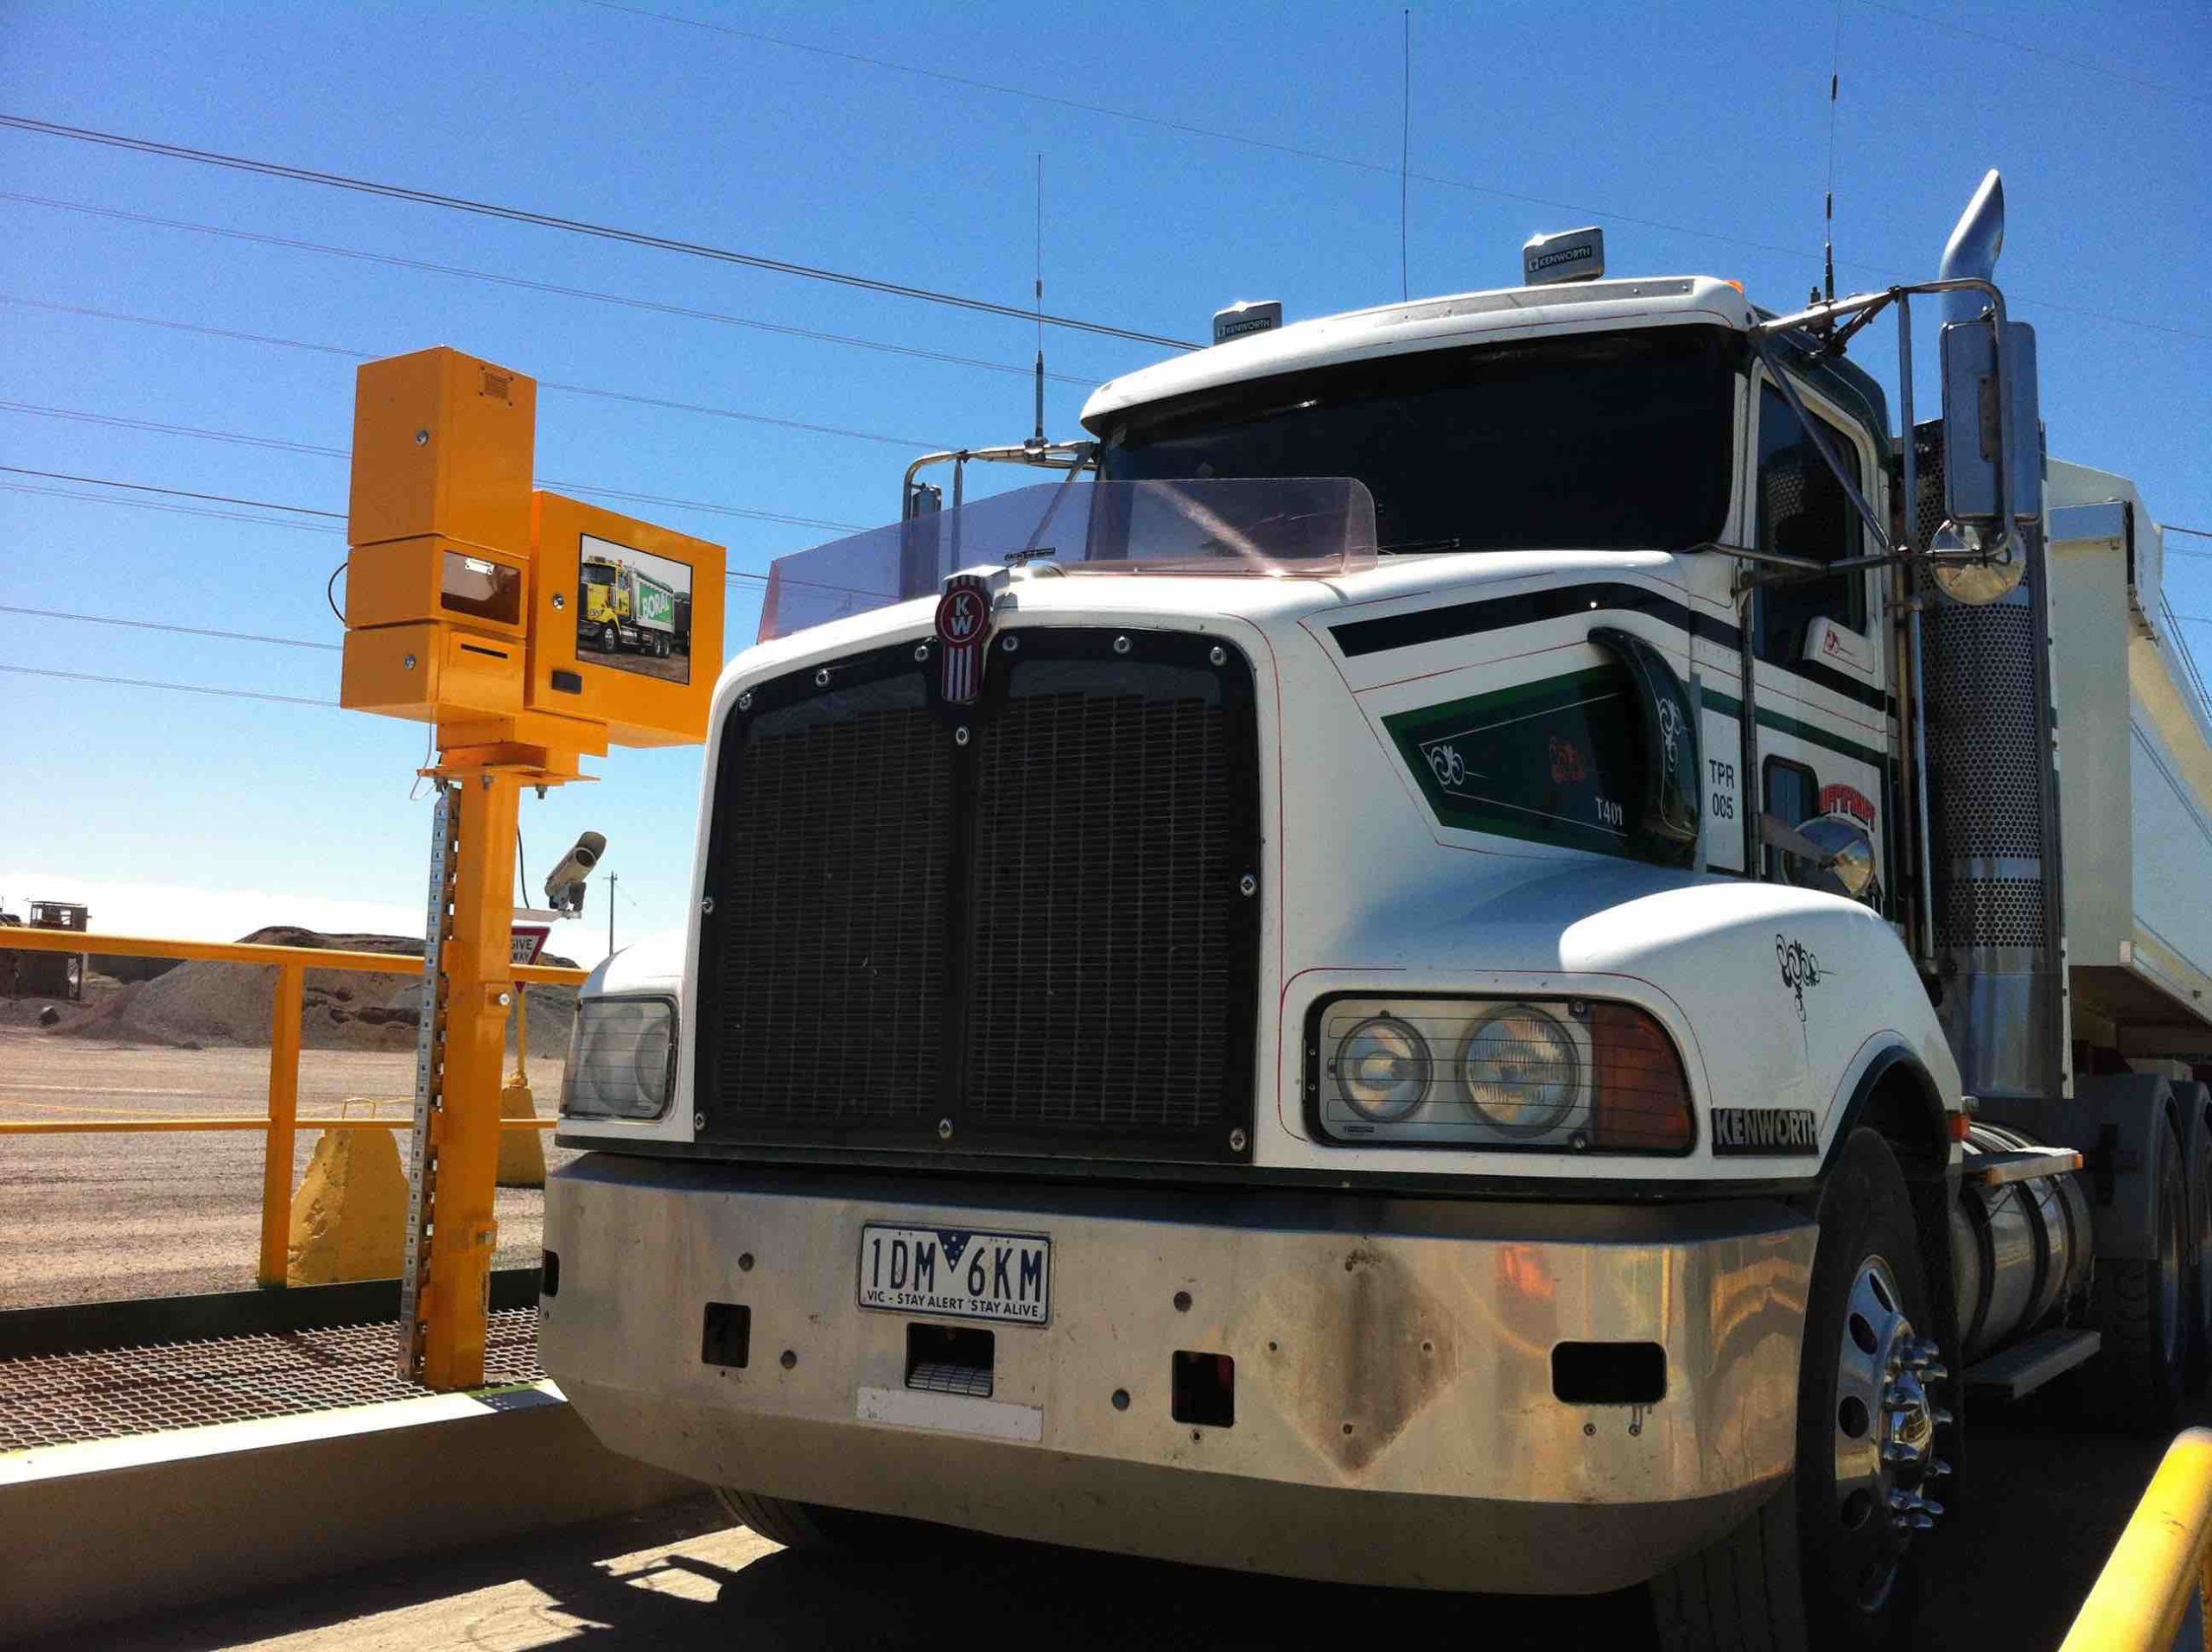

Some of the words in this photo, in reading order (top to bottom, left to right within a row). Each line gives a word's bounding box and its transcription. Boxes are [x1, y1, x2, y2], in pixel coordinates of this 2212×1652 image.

[1539, 247, 1591, 267] KENWORTH
[1226, 319, 1270, 334] KENWORTH
[642, 592, 669, 620] BORAL
[1708, 759, 1735, 790] TPR
[1595, 796, 1623, 827] T401
[1714, 1109, 1817, 1147] KENWORTH
[873, 1238, 936, 1293] 1DM
[968, 1247, 1043, 1303] 6KM
[867, 1289, 886, 1303] VIC
[897, 1293, 925, 1306] STAY
[927, 1296, 964, 1311] ALERT
[970, 1299, 1001, 1313] STAY
[1003, 1302, 1039, 1318] ALIVE
